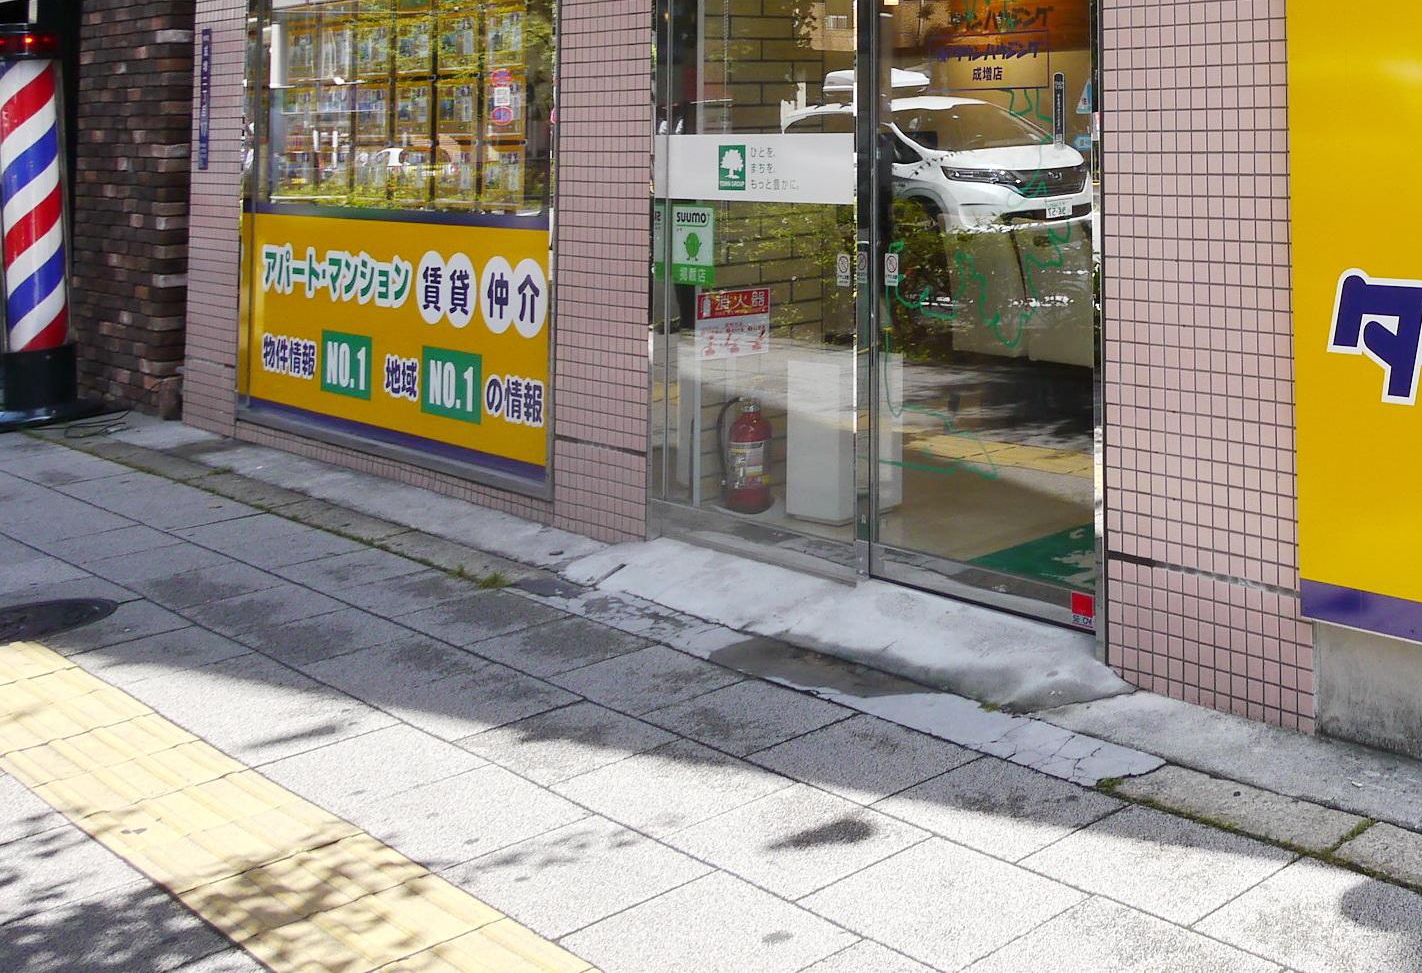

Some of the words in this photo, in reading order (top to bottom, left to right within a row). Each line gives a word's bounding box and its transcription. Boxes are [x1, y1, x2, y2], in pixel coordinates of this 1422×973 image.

[972, 66, 1003, 82] 成増店
[422, 266, 470, 314] 賃貸
[487, 272, 540, 324] 仲介
[263, 336, 316, 378] 物件情報
[326, 341, 368, 391] NO.1
[385, 358, 418, 400] 地域
[428, 360, 474, 413] NO.1
[486, 376, 543, 425] の情報
